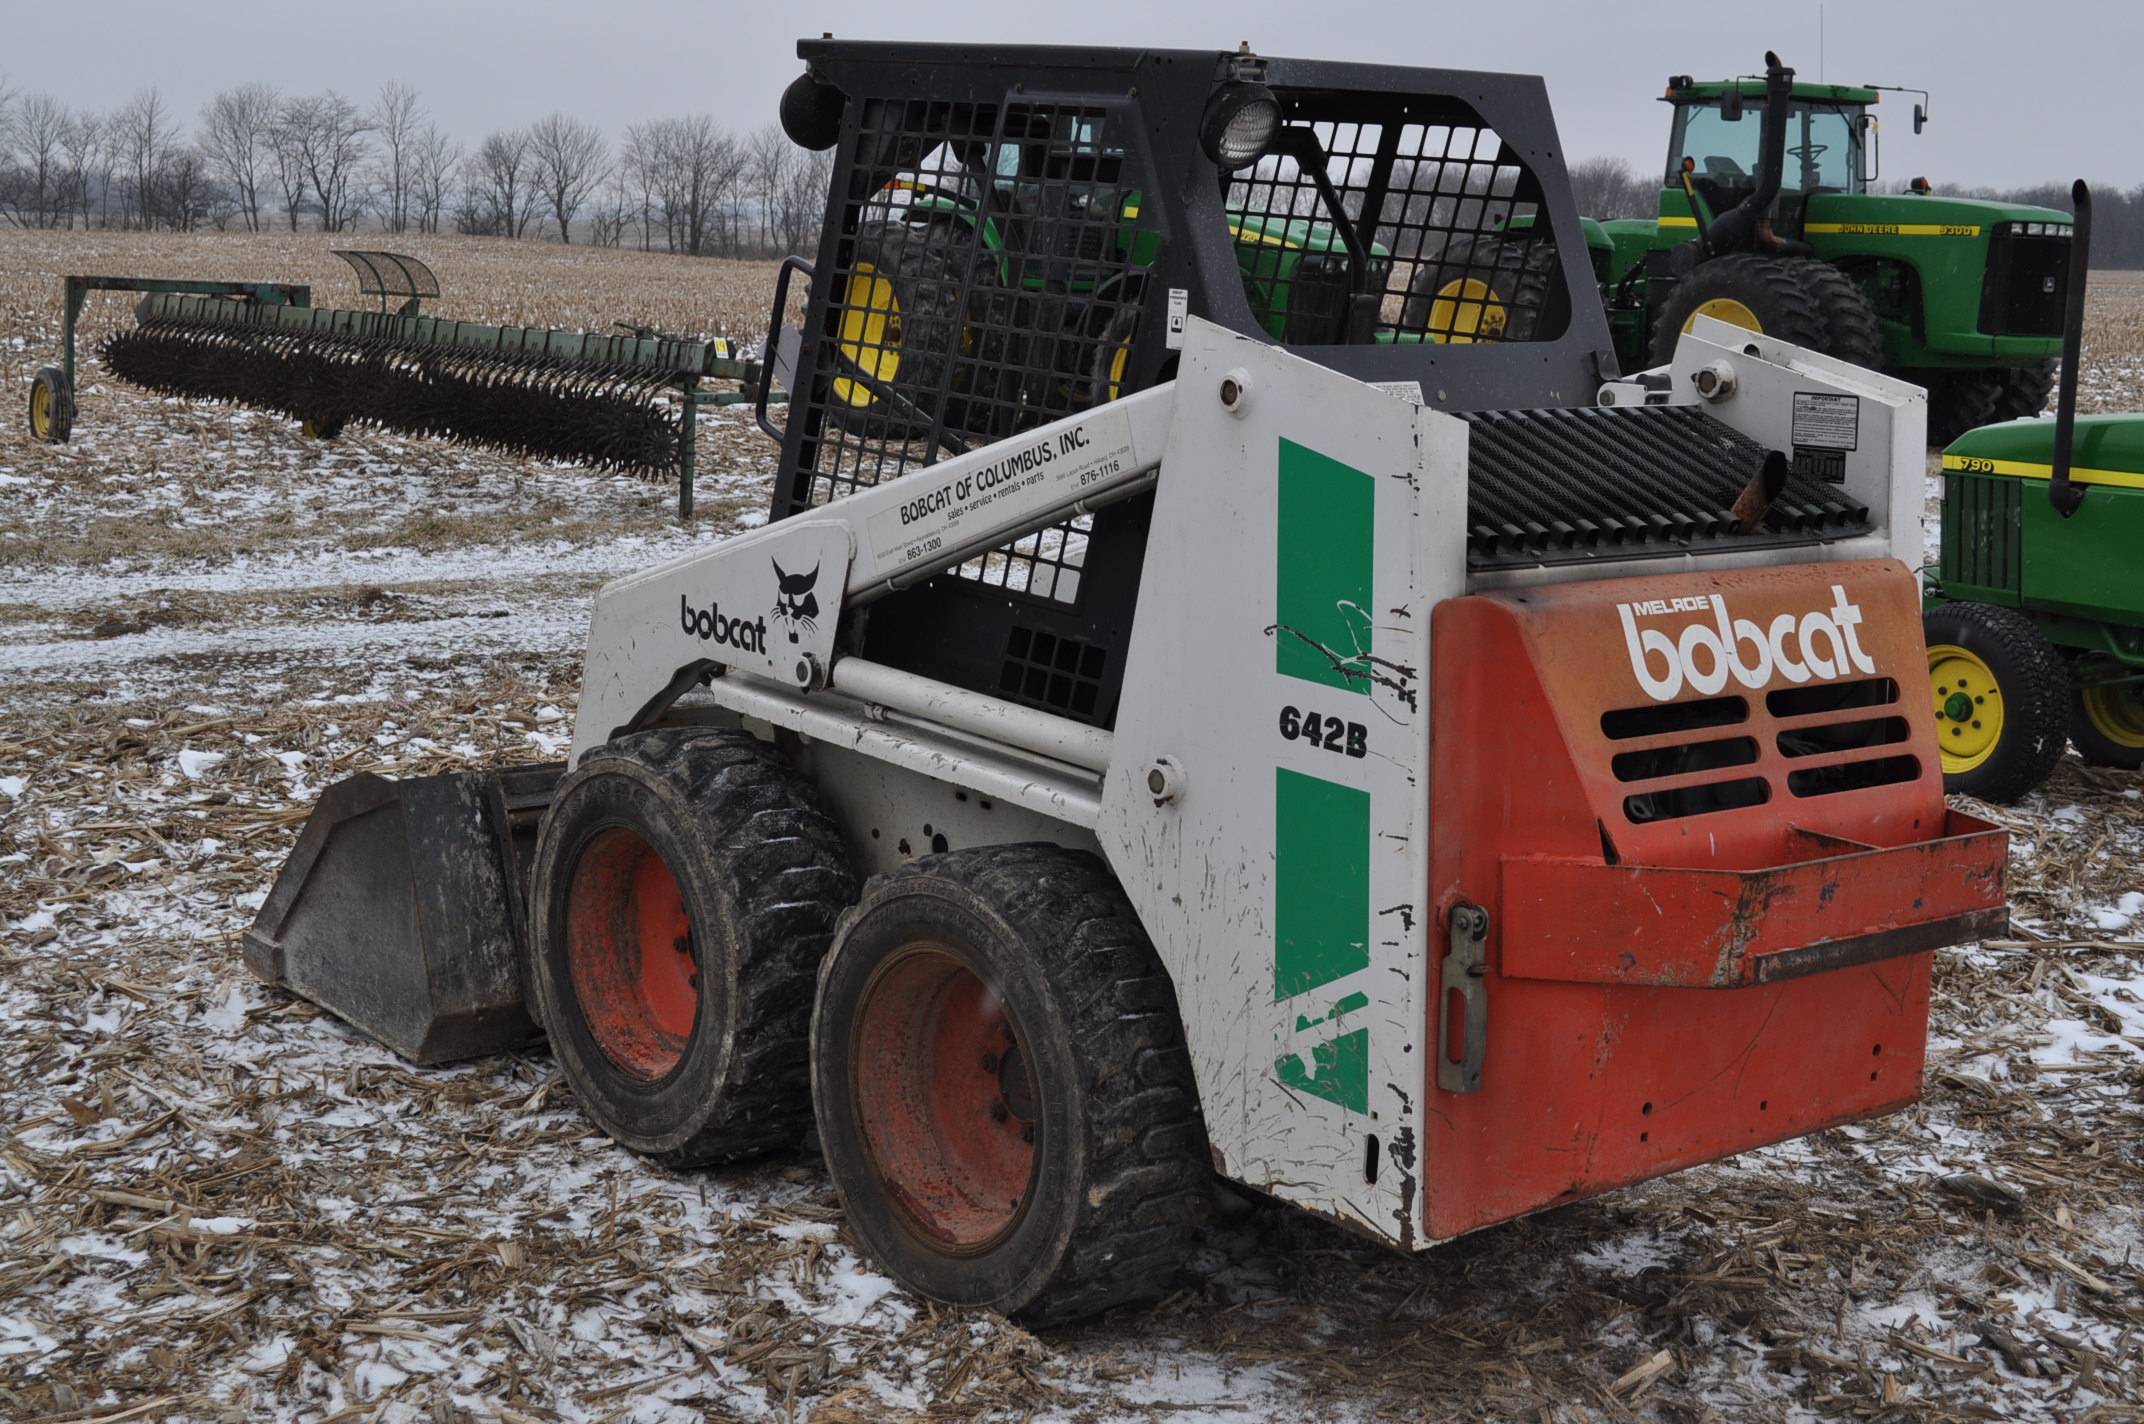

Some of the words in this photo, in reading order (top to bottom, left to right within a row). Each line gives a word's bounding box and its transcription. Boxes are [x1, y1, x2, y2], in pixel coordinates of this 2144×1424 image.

[1839, 223, 1864, 234] JOHN
[1864, 224, 1899, 235] DEERE
[1940, 225, 1973, 237] 9300
[900, 486, 951, 525] BOBCAT
[956, 476, 972, 501] OF
[976, 442, 1057, 491] COLUMBUS,
[1059, 427, 1090, 455] INC.
[1080, 460, 1120, 486] 876-1116
[1961, 457, 1994, 473] 790
[948, 506, 964, 520] sales
[969, 493, 992, 511] service
[998, 480, 1020, 498] rentals
[1026, 471, 1044, 486] parts
[907, 537, 942, 560] 863-1300
[1632, 595, 1710, 616] MELROE
[681, 594, 767, 655] bobcat
[1616, 585, 1876, 701] bobcat
[1279, 705, 1368, 759] 642B
